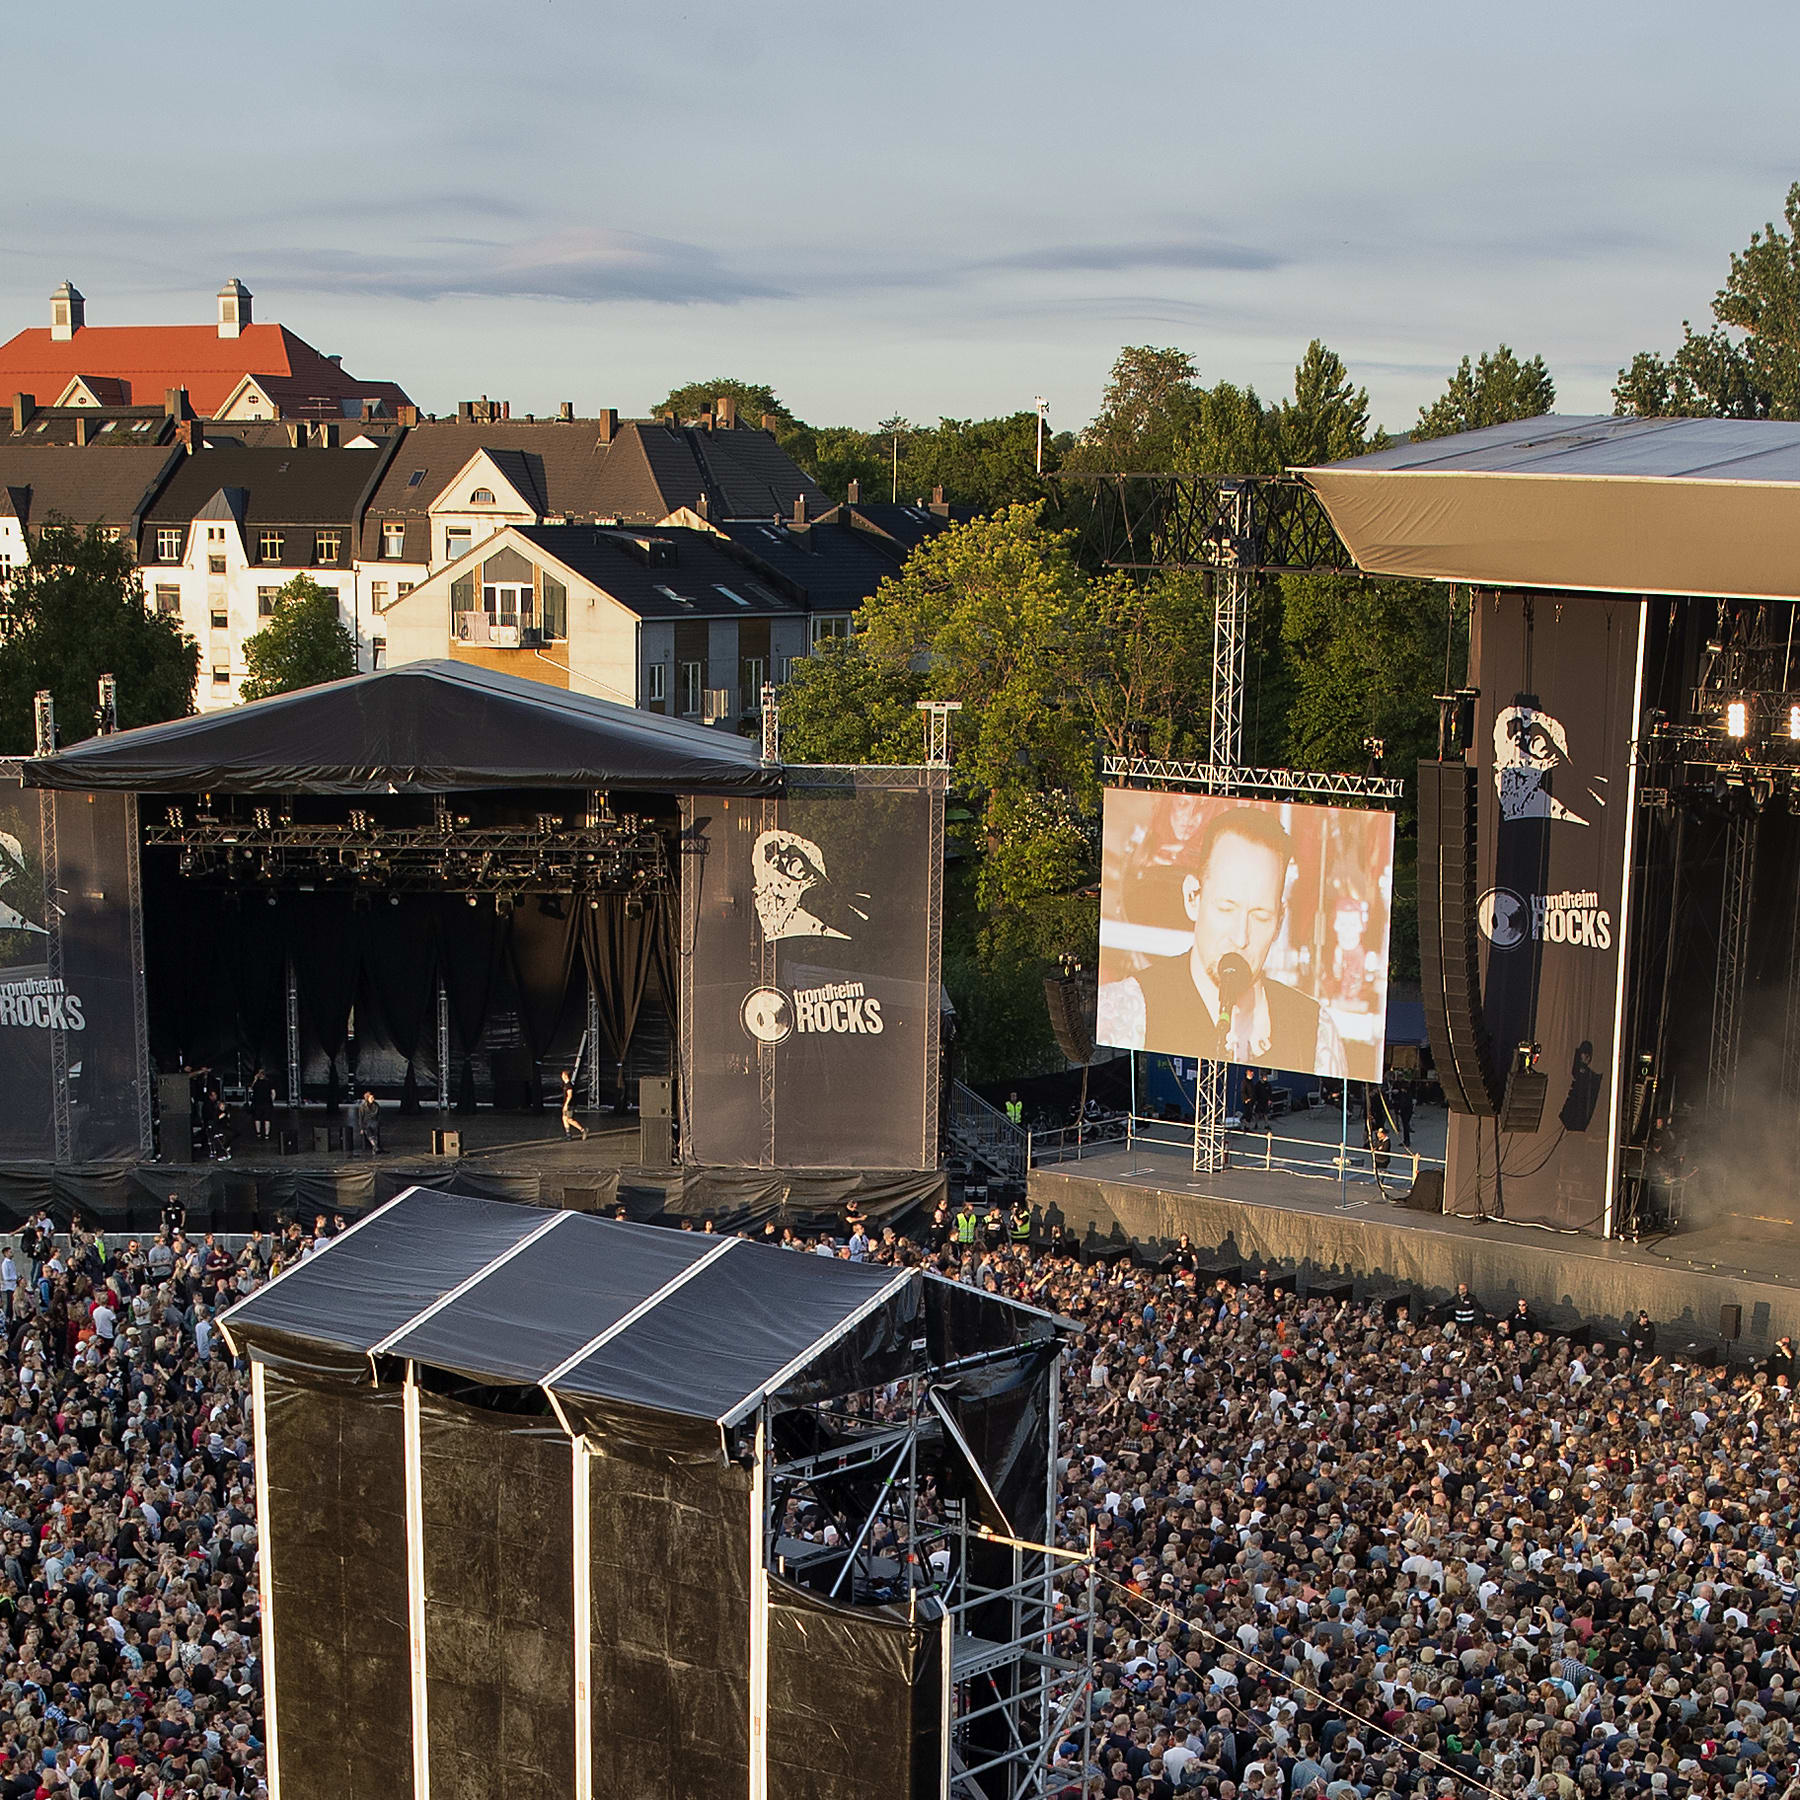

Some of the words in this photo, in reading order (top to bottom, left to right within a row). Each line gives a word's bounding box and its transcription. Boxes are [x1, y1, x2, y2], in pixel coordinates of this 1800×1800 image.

[1530, 889, 1599, 910] trondheim
[1532, 909, 1612, 950] ROCKS
[793, 980, 865, 1003] trondheim
[0, 995, 86, 1031] ROCKS
[796, 998, 884, 1034] ROCKS
